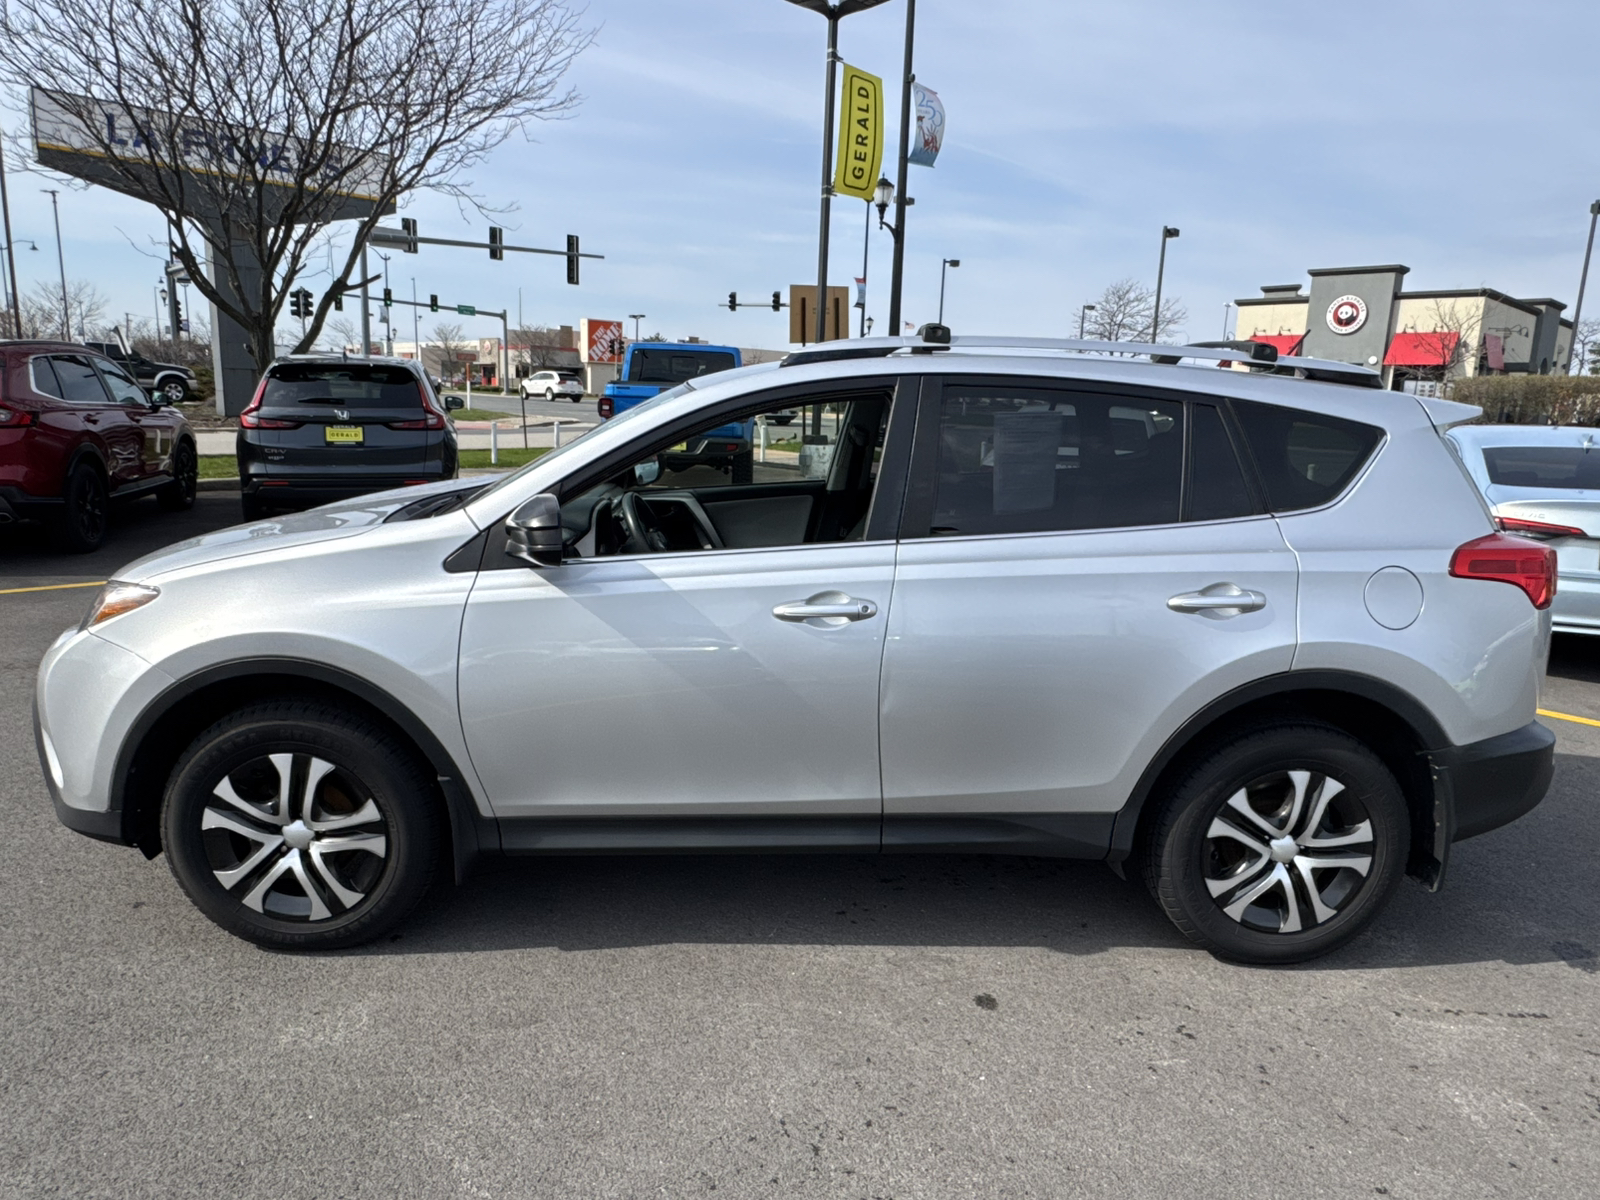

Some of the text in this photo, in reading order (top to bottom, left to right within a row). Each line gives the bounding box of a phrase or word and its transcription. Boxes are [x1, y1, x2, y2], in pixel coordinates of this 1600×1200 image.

[915, 89, 943, 127] 250
[107, 112, 163, 153] LA
[852, 86, 870, 180] GERALD
[1328, 296, 1366, 314] PANDA EXPRESS
[589, 322, 622, 361] HOME
[592, 325, 607, 342] THE
